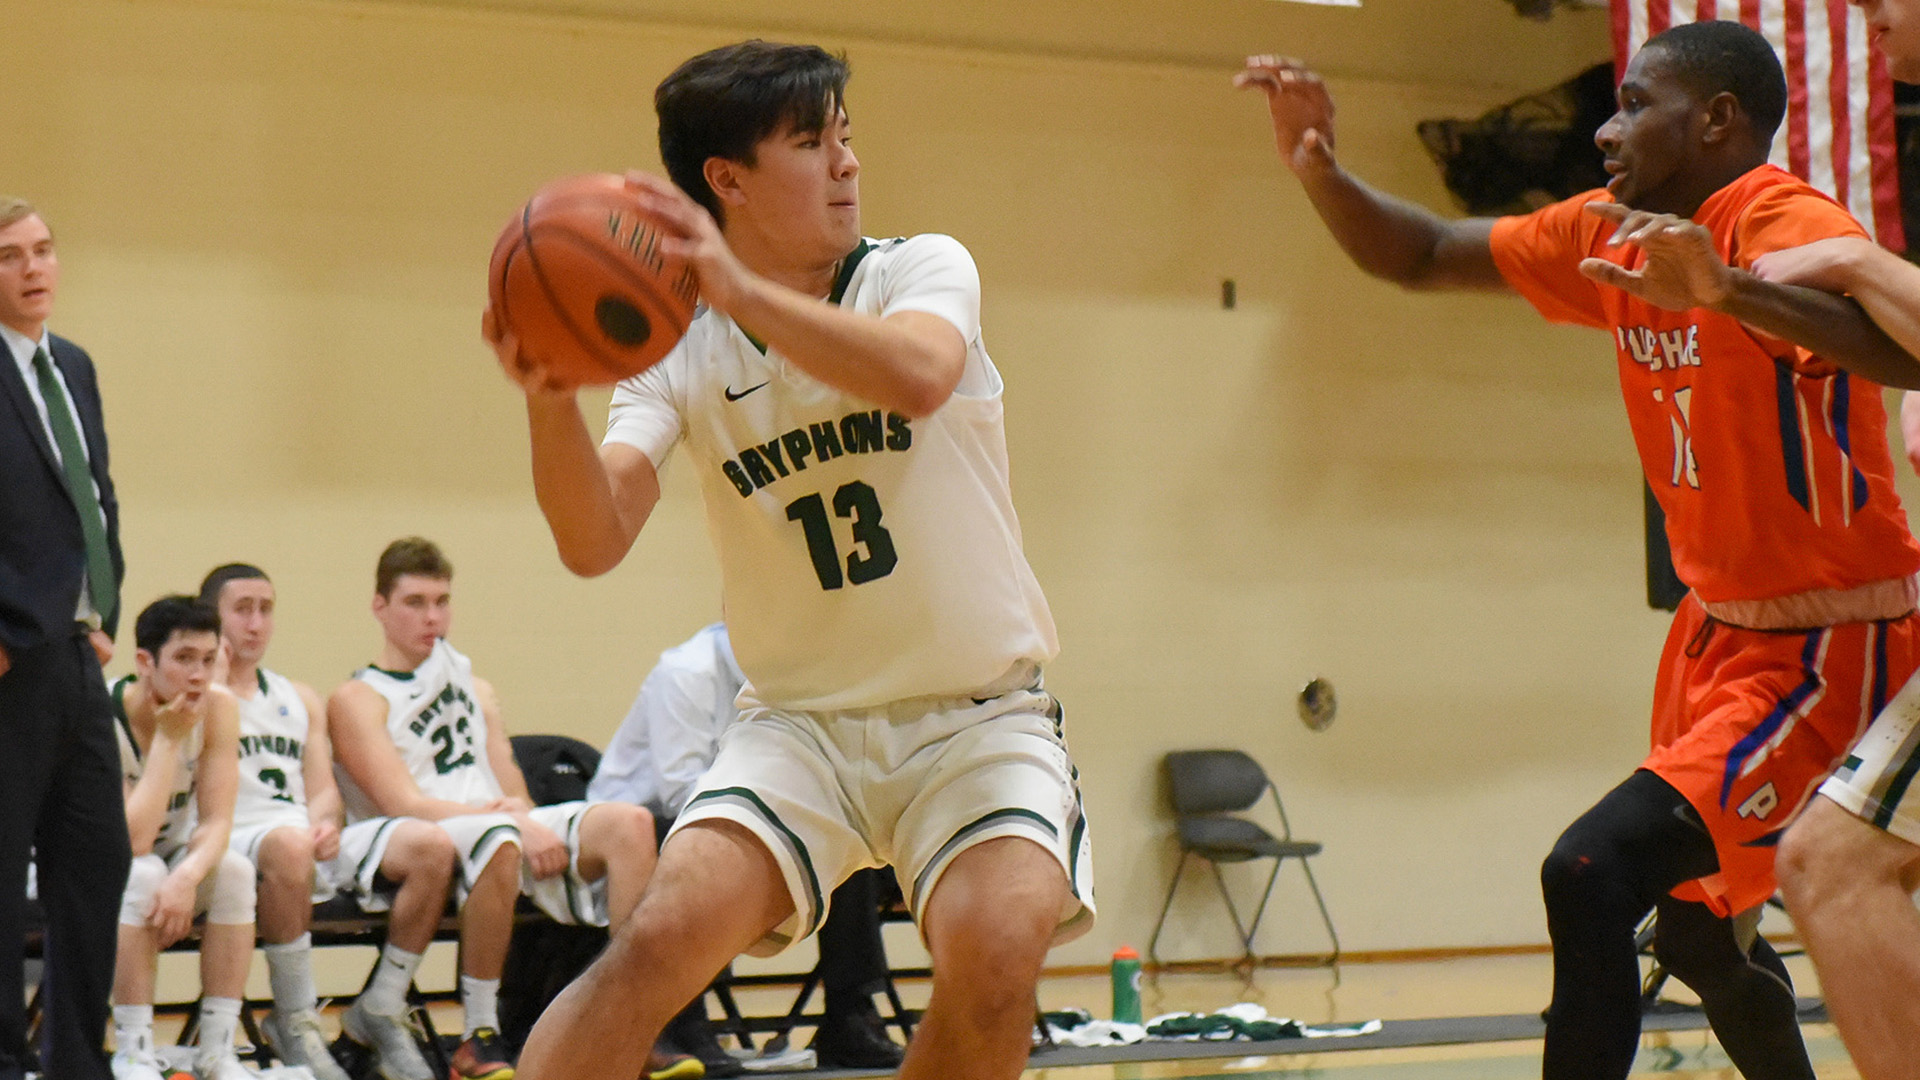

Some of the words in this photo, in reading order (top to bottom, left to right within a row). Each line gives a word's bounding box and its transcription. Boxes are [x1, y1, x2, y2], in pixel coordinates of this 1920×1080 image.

[722, 409, 912, 498] GRYPHONS
[785, 480, 898, 590] 13
[1737, 781, 1778, 821] P
